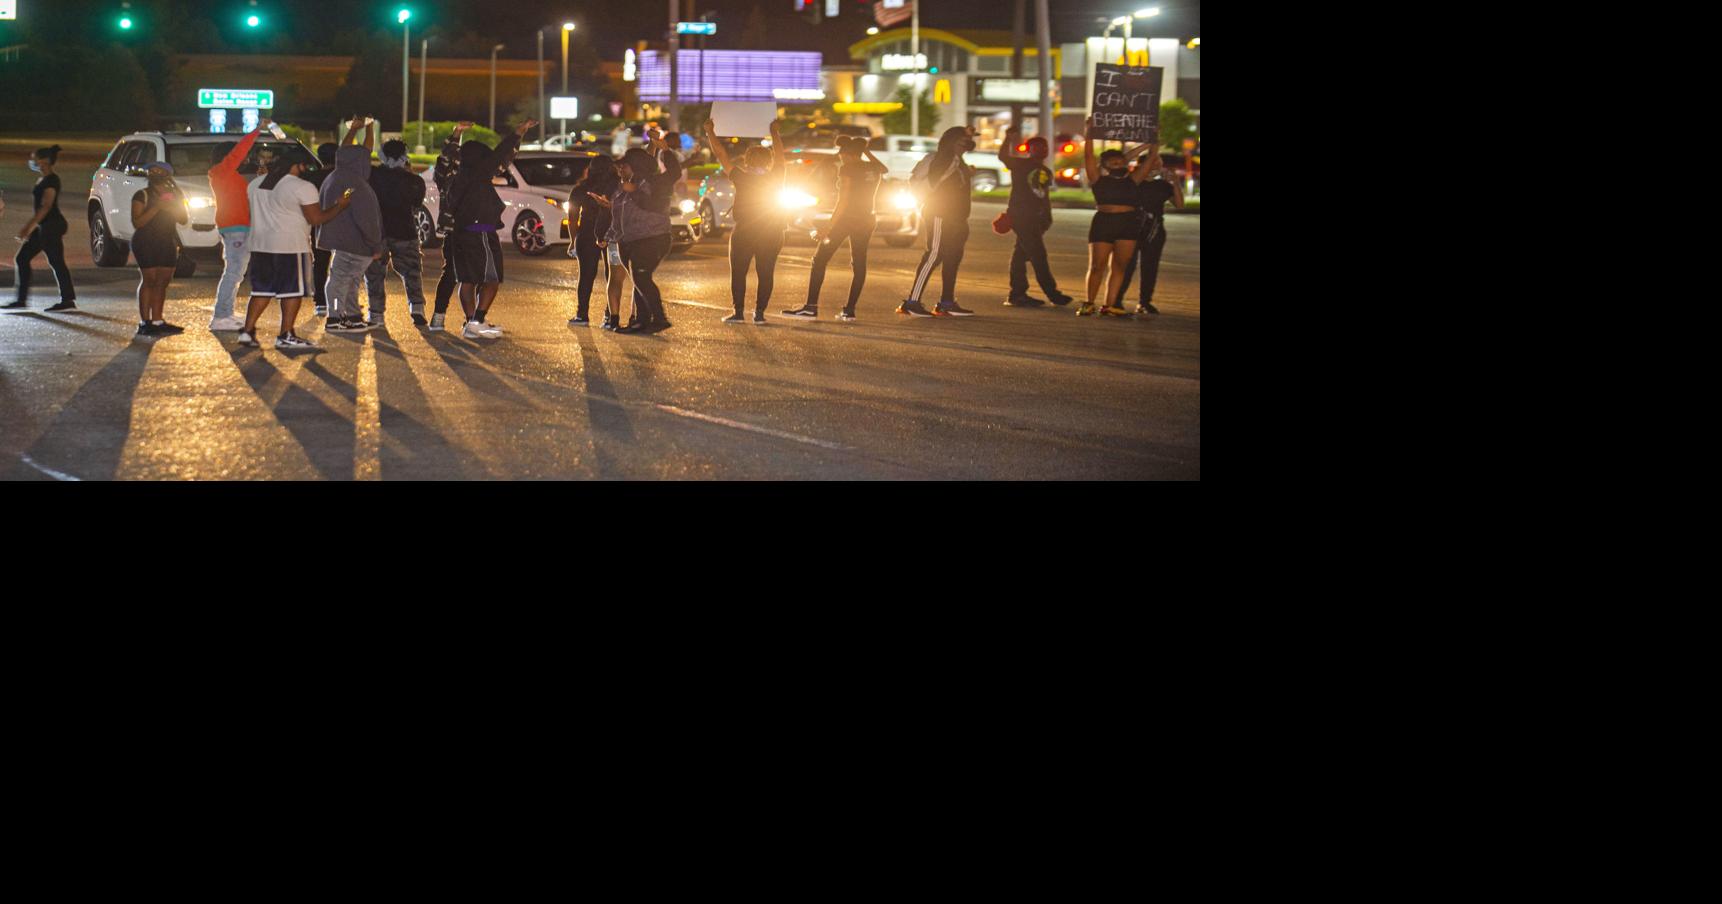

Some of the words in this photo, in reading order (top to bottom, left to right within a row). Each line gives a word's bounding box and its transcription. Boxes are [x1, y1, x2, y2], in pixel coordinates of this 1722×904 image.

[1096, 70, 1120, 88] I
[1096, 92, 1156, 111] CAN'T
[1093, 111, 1156, 129] BREATHE
